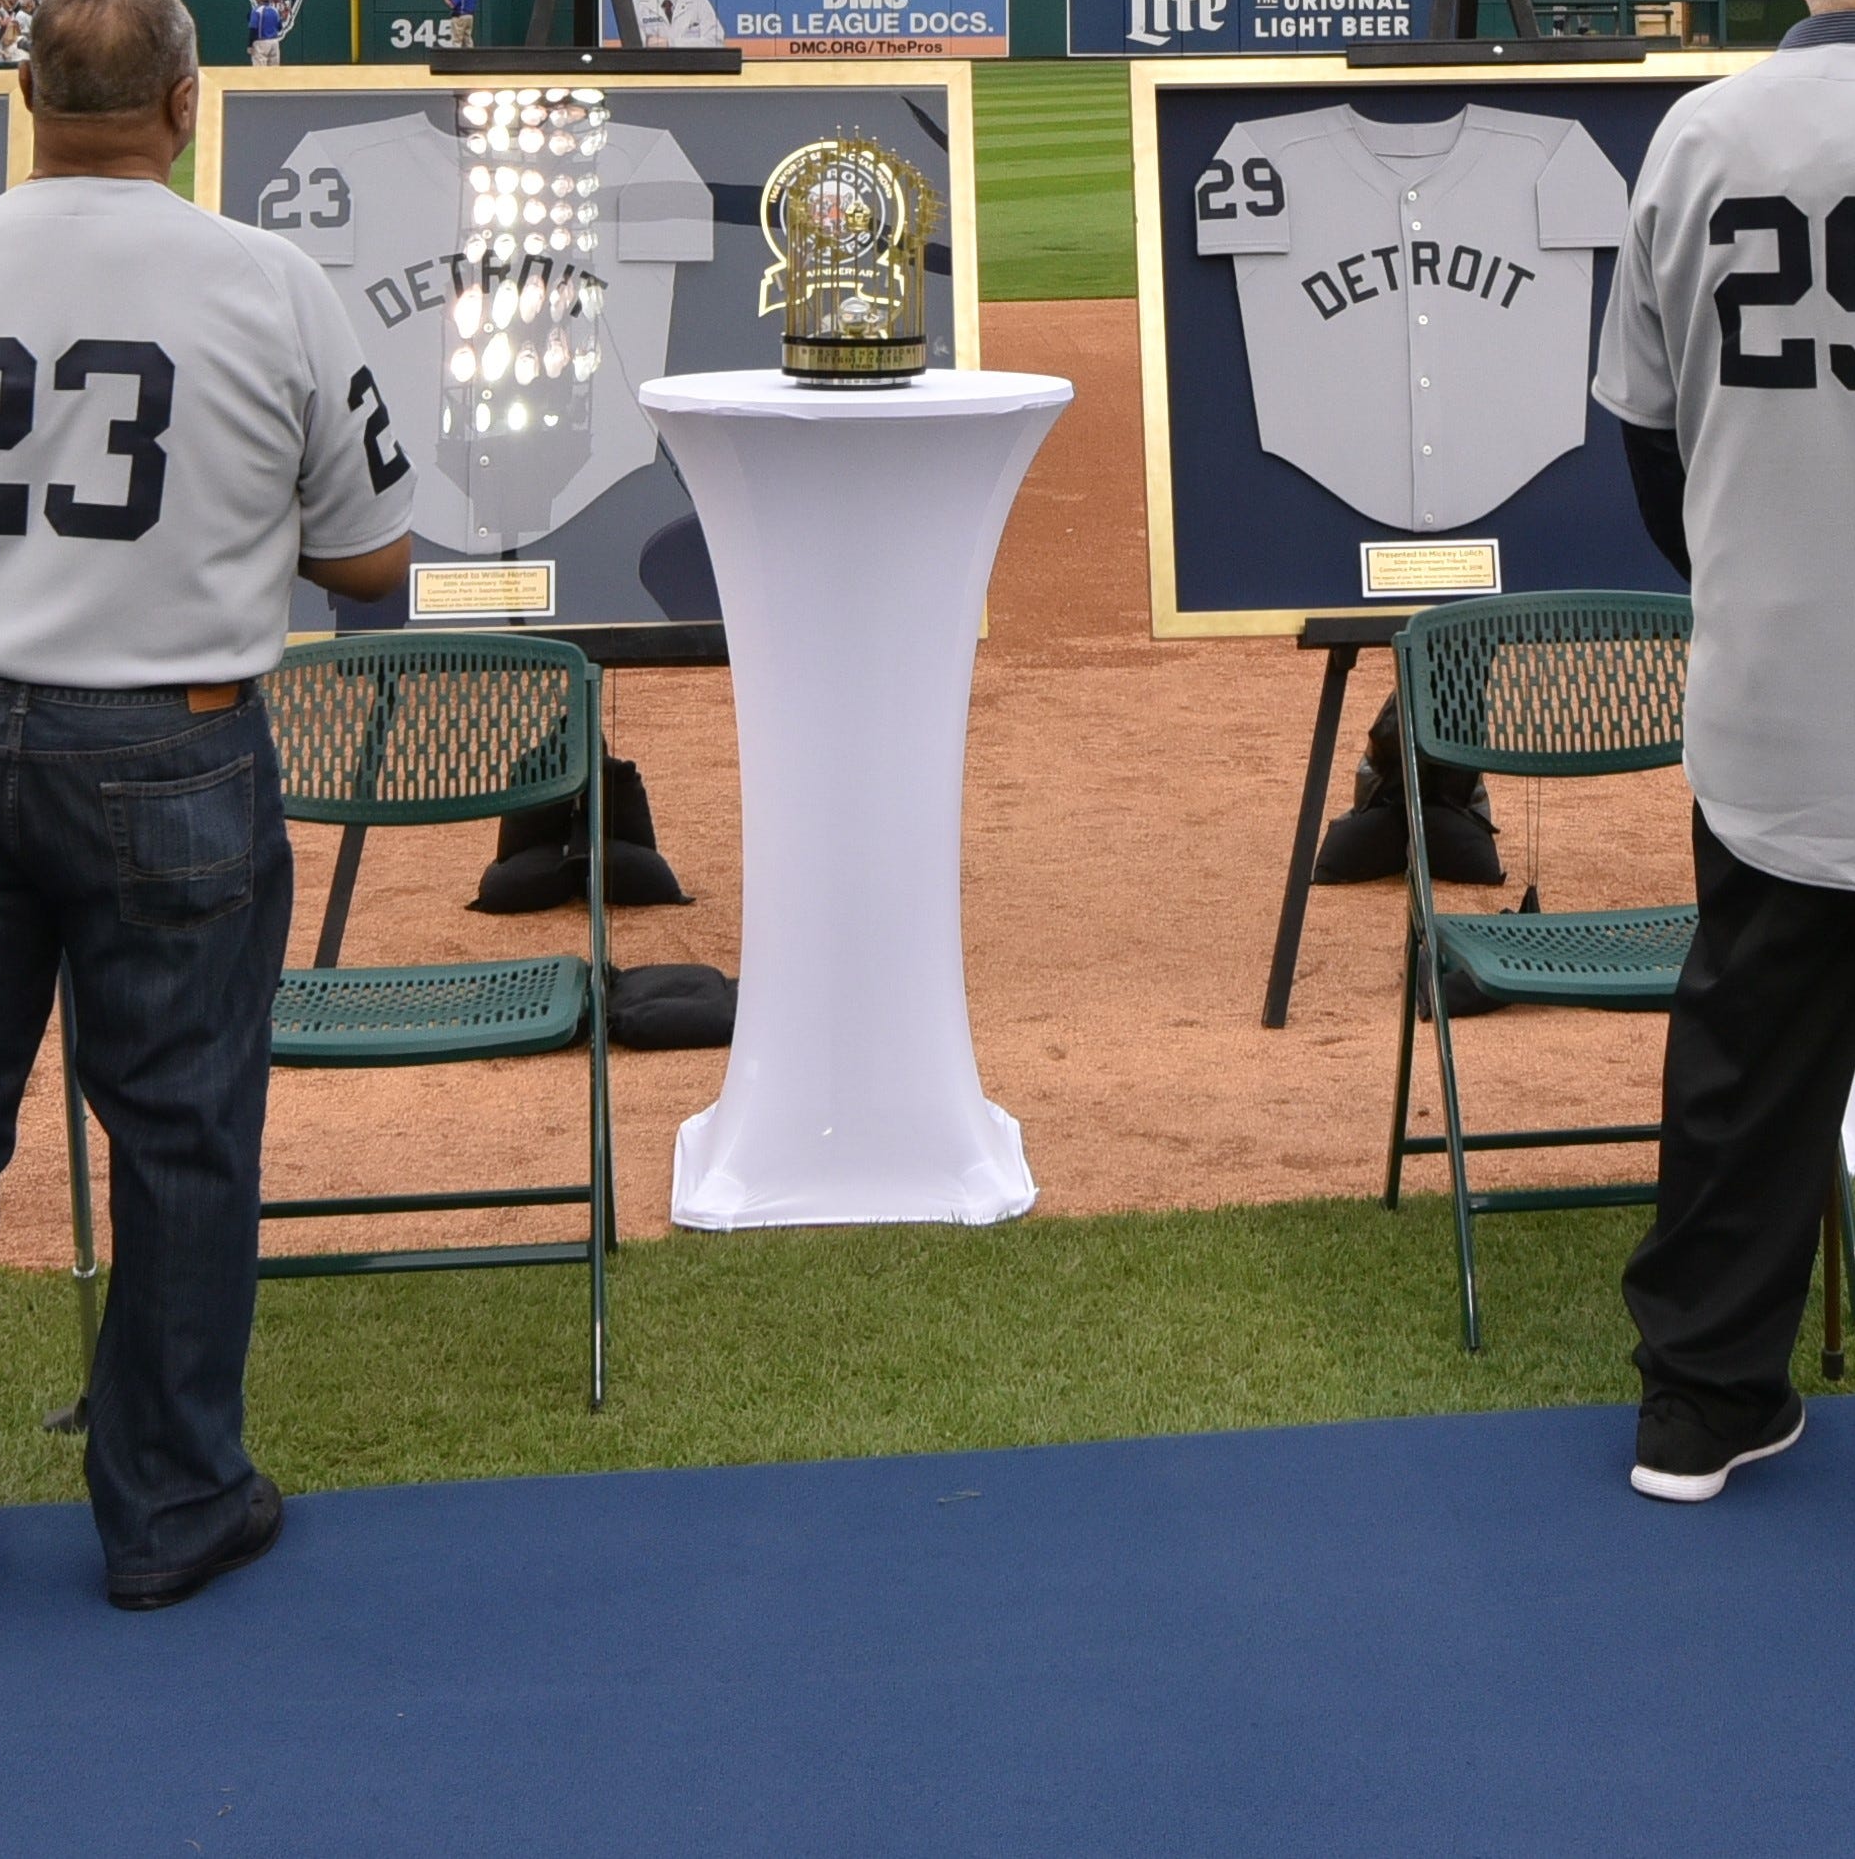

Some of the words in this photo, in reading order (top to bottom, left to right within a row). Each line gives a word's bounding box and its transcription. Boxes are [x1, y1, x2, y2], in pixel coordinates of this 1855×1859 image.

[390, 19, 453, 48] 345
[737, 13, 782, 35] BIG
[793, 13, 904, 34] LEAGUE
[909, 12, 994, 34] DOCS.
[1255, 17, 1332, 38] LIGHT
[1342, 16, 1410, 37] BEER
[261, 168, 351, 230] 23
[1197, 158, 1285, 221] 29
[1301, 240, 1535, 321] DETROIT
[427, 572, 469, 581] Presented
